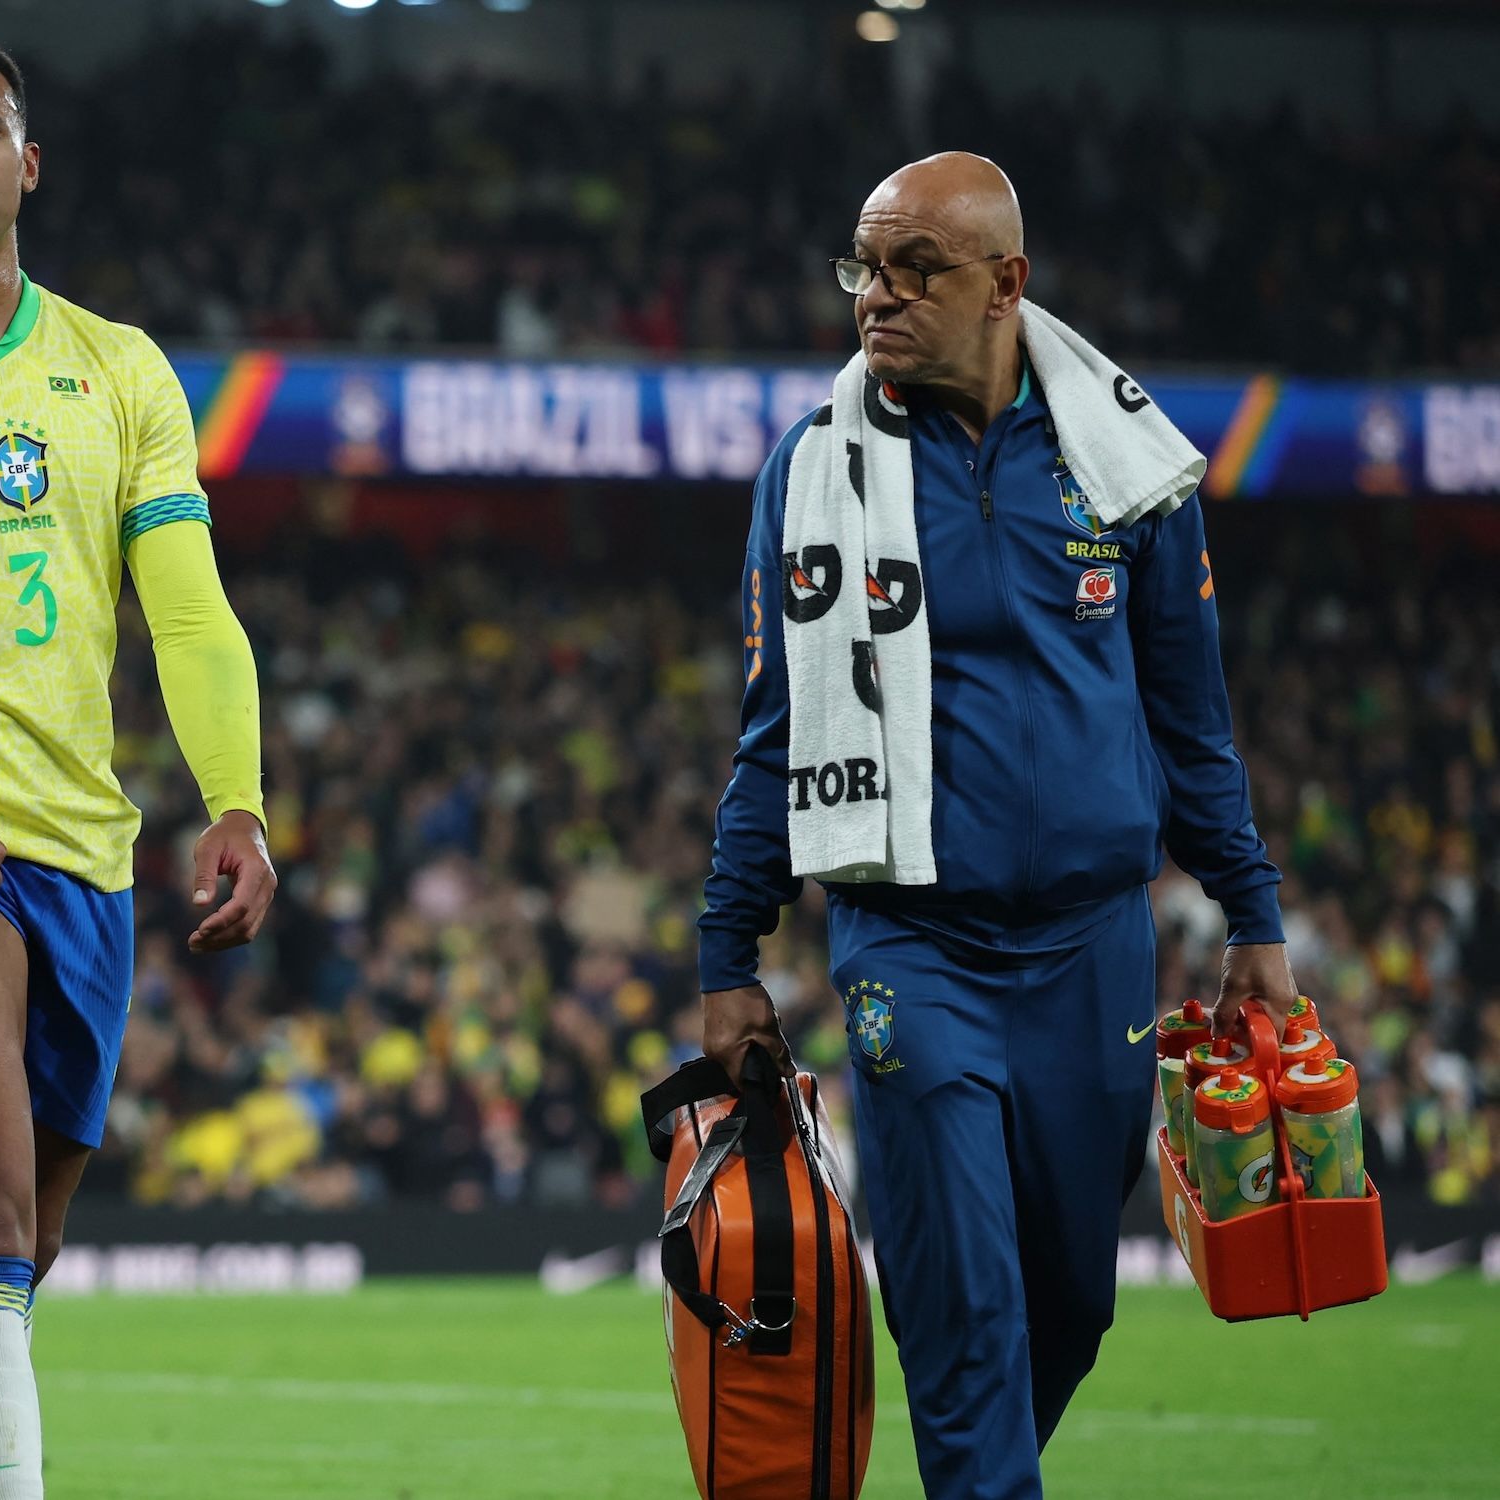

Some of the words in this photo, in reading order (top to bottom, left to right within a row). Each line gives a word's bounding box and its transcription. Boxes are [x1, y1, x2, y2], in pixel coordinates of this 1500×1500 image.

[402, 364, 661, 476] BRAZIL
[664, 366, 764, 479] VS
[7, 462, 31, 475] CBF
[1066, 541, 1121, 559] BRASIL
[8, 550, 58, 647] 3
[788, 757, 887, 811] TOR
[864, 1019, 879, 1030] CBF
